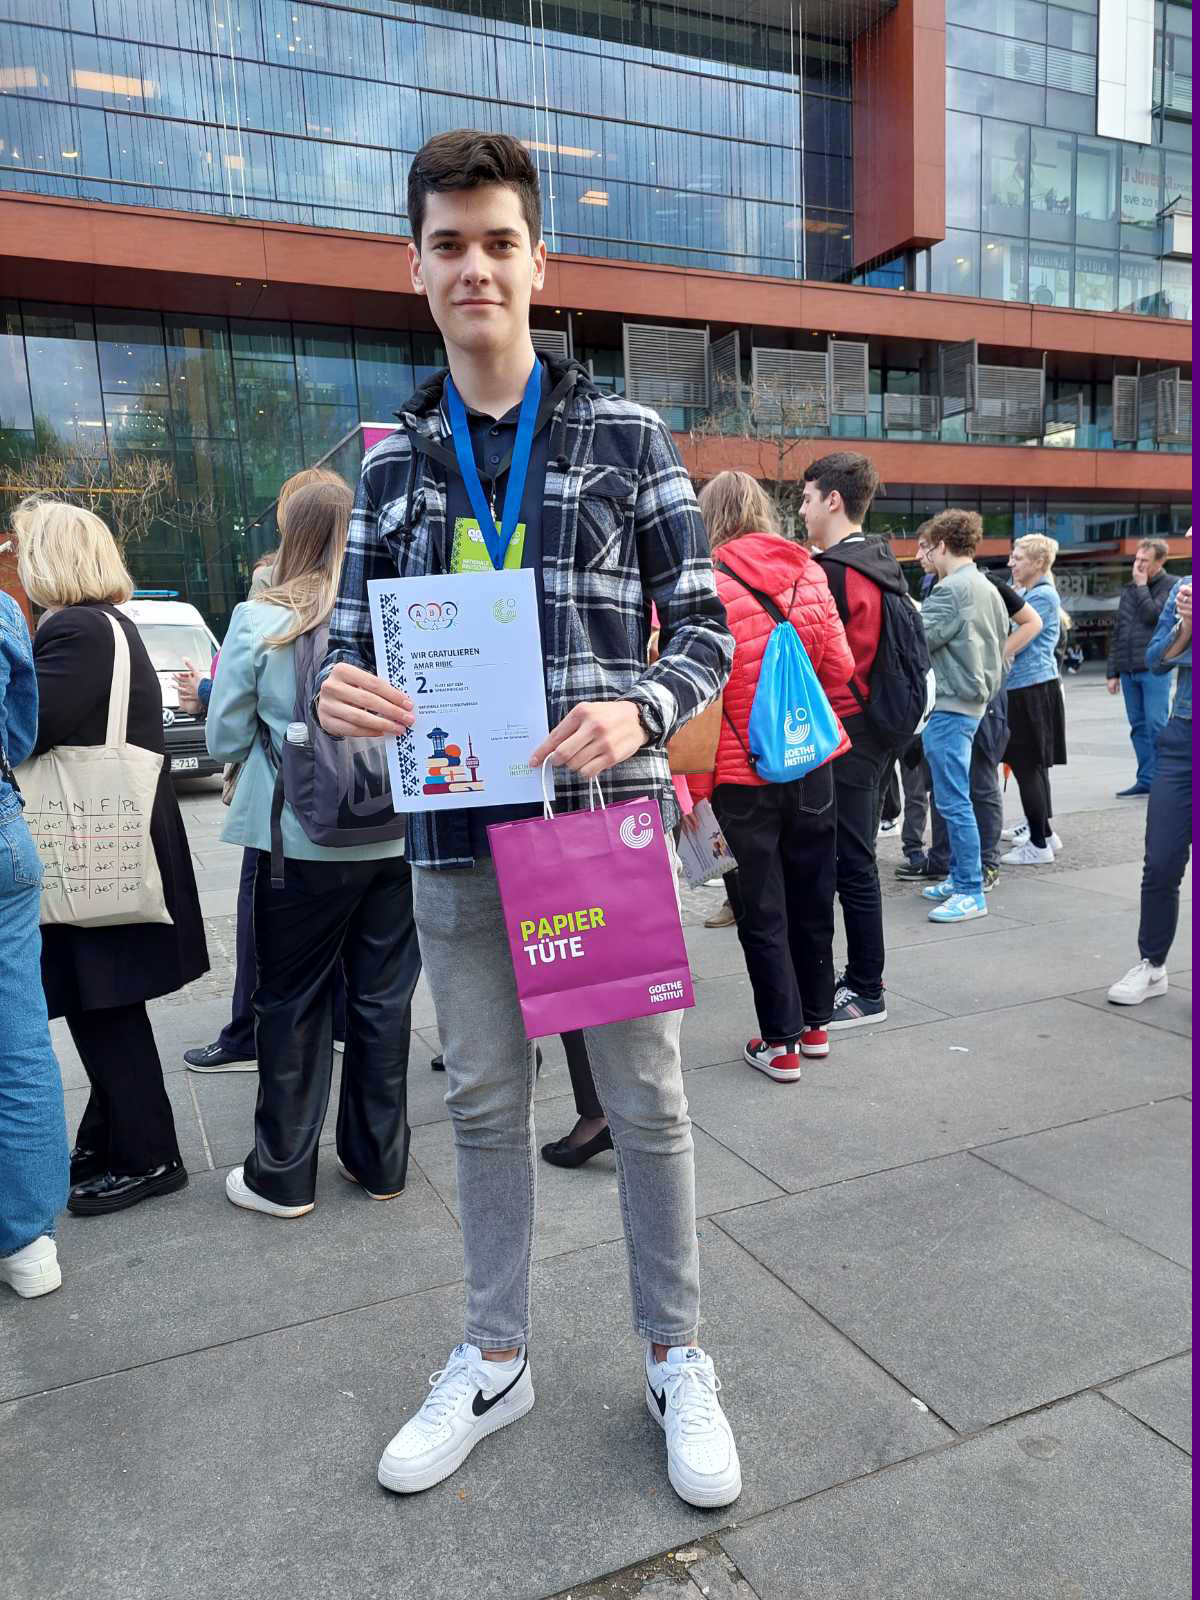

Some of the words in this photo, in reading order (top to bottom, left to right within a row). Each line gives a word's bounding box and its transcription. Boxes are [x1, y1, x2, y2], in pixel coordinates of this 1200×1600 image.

[428, 648, 480, 658] GRATULIEREN
[413, 661, 434, 670] AMAR
[415, 676, 434, 694] 2.
[784, 753, 816, 767] INSTITUT
[49, 801, 63, 811] M
[73, 801, 84, 812] N
[101, 799, 110, 812] F
[122, 800, 139, 811] PL
[44, 820, 63, 830] der
[71, 822, 87, 832] das
[95, 822, 115, 833] die
[123, 822, 141, 831] die
[40, 840, 62, 850] den
[95, 842, 115, 852] die
[122, 842, 142, 852] die
[95, 860, 115, 872] der
[65, 883, 87, 894] des
[95, 882, 115, 894] der
[121, 881, 140, 893] der
[520, 907, 607, 942] PAPIER
[523, 936, 585, 966] TÜTE
[648, 980, 683, 995] GOETHE
[650, 989, 684, 1003] INSTITUT
